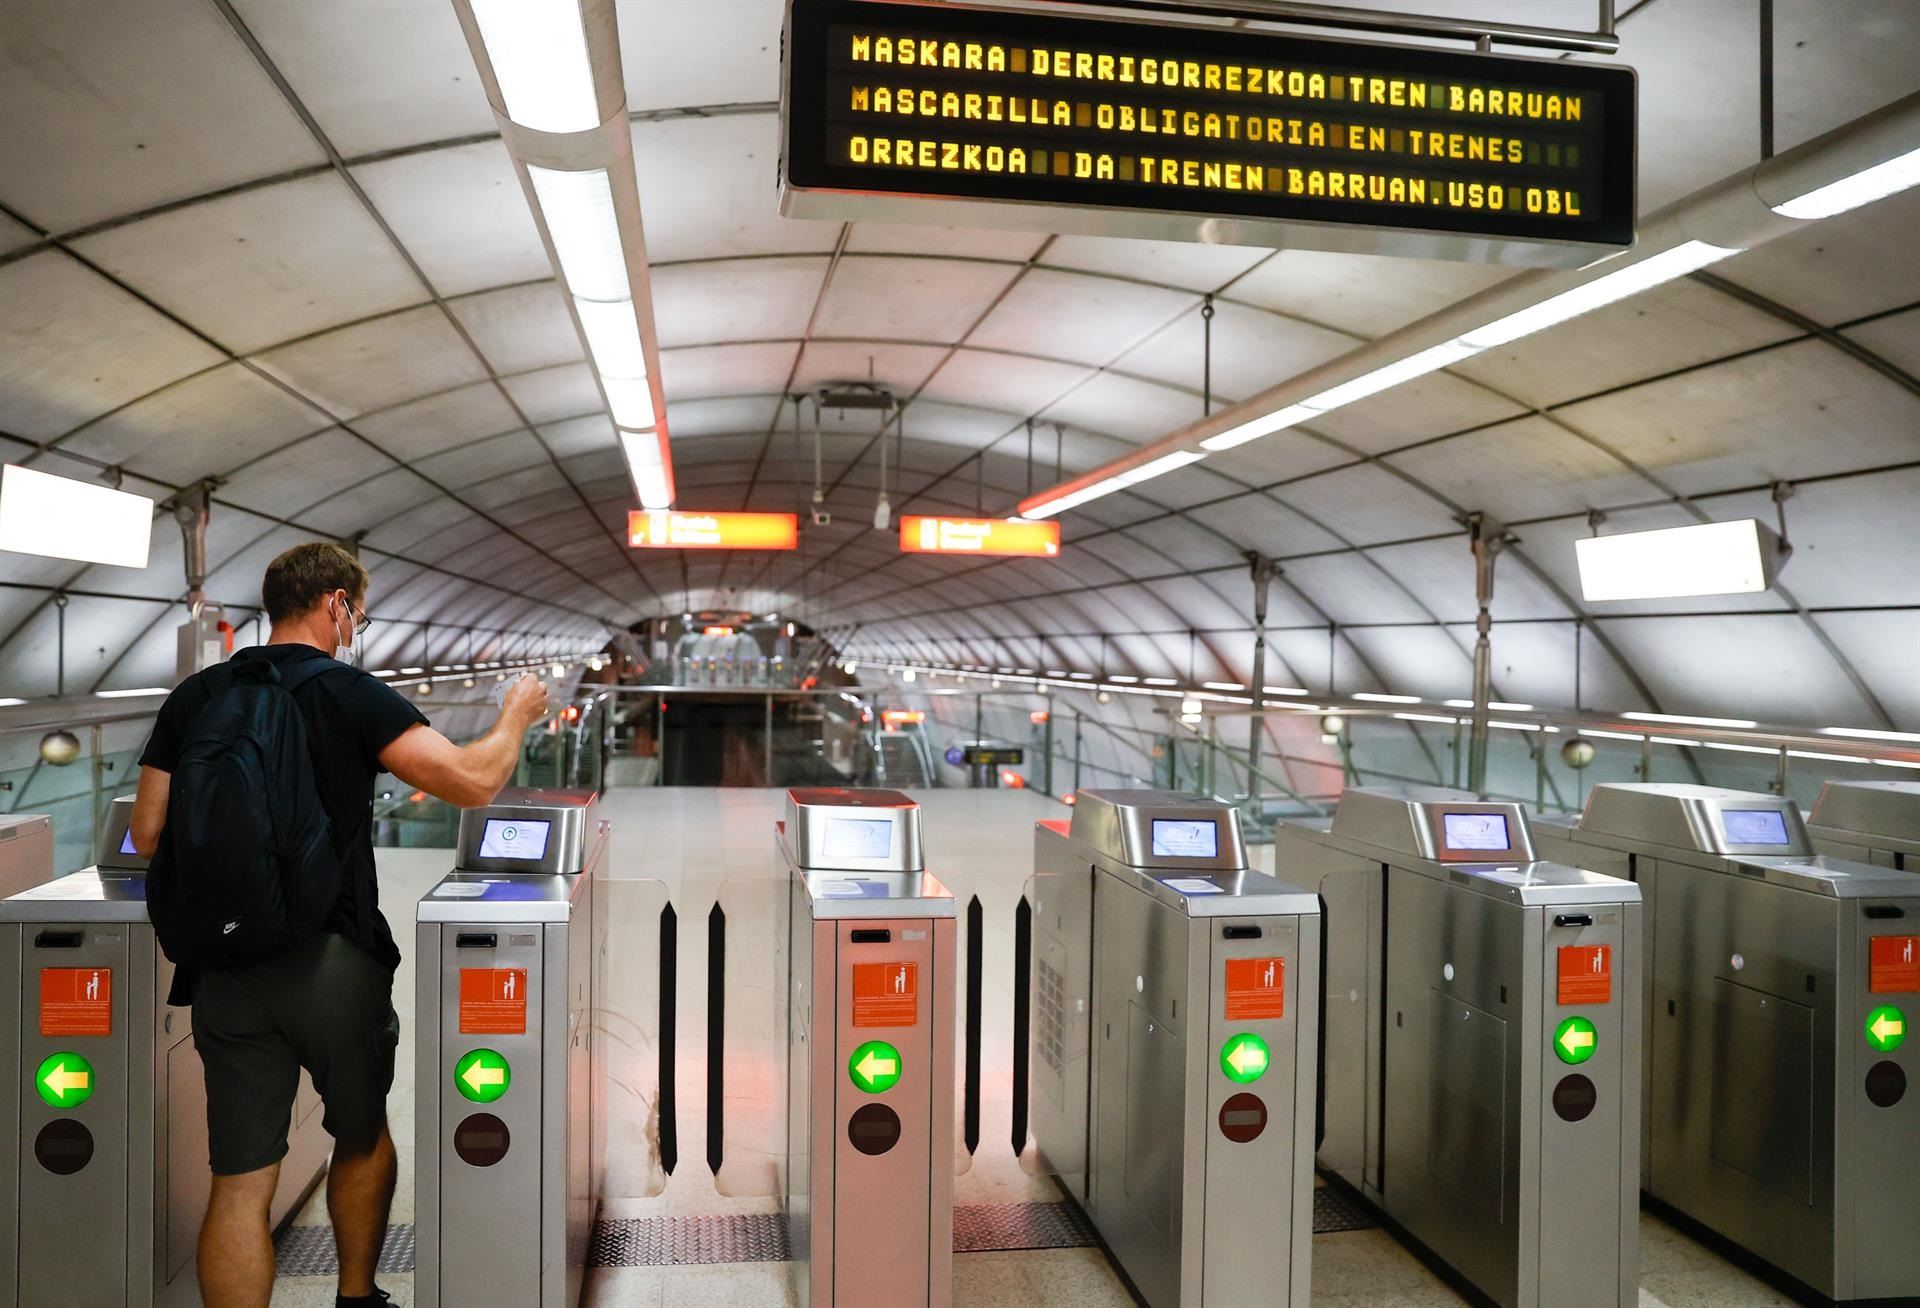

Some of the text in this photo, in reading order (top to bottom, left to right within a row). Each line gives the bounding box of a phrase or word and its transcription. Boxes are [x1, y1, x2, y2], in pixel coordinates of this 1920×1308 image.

[852, 35, 1581, 121] MASKARA DERRIGORREZKOA TREN BARRUAN
[851, 86, 1523, 164] MASCARILLA OBLIGATORIA EN TRENES
[850, 136, 1026, 174] ORREZKOA
[1075, 152, 1114, 180] DA
[1140, 157, 1263, 191] TRENEN
[1526, 188, 1581, 216] OBL
